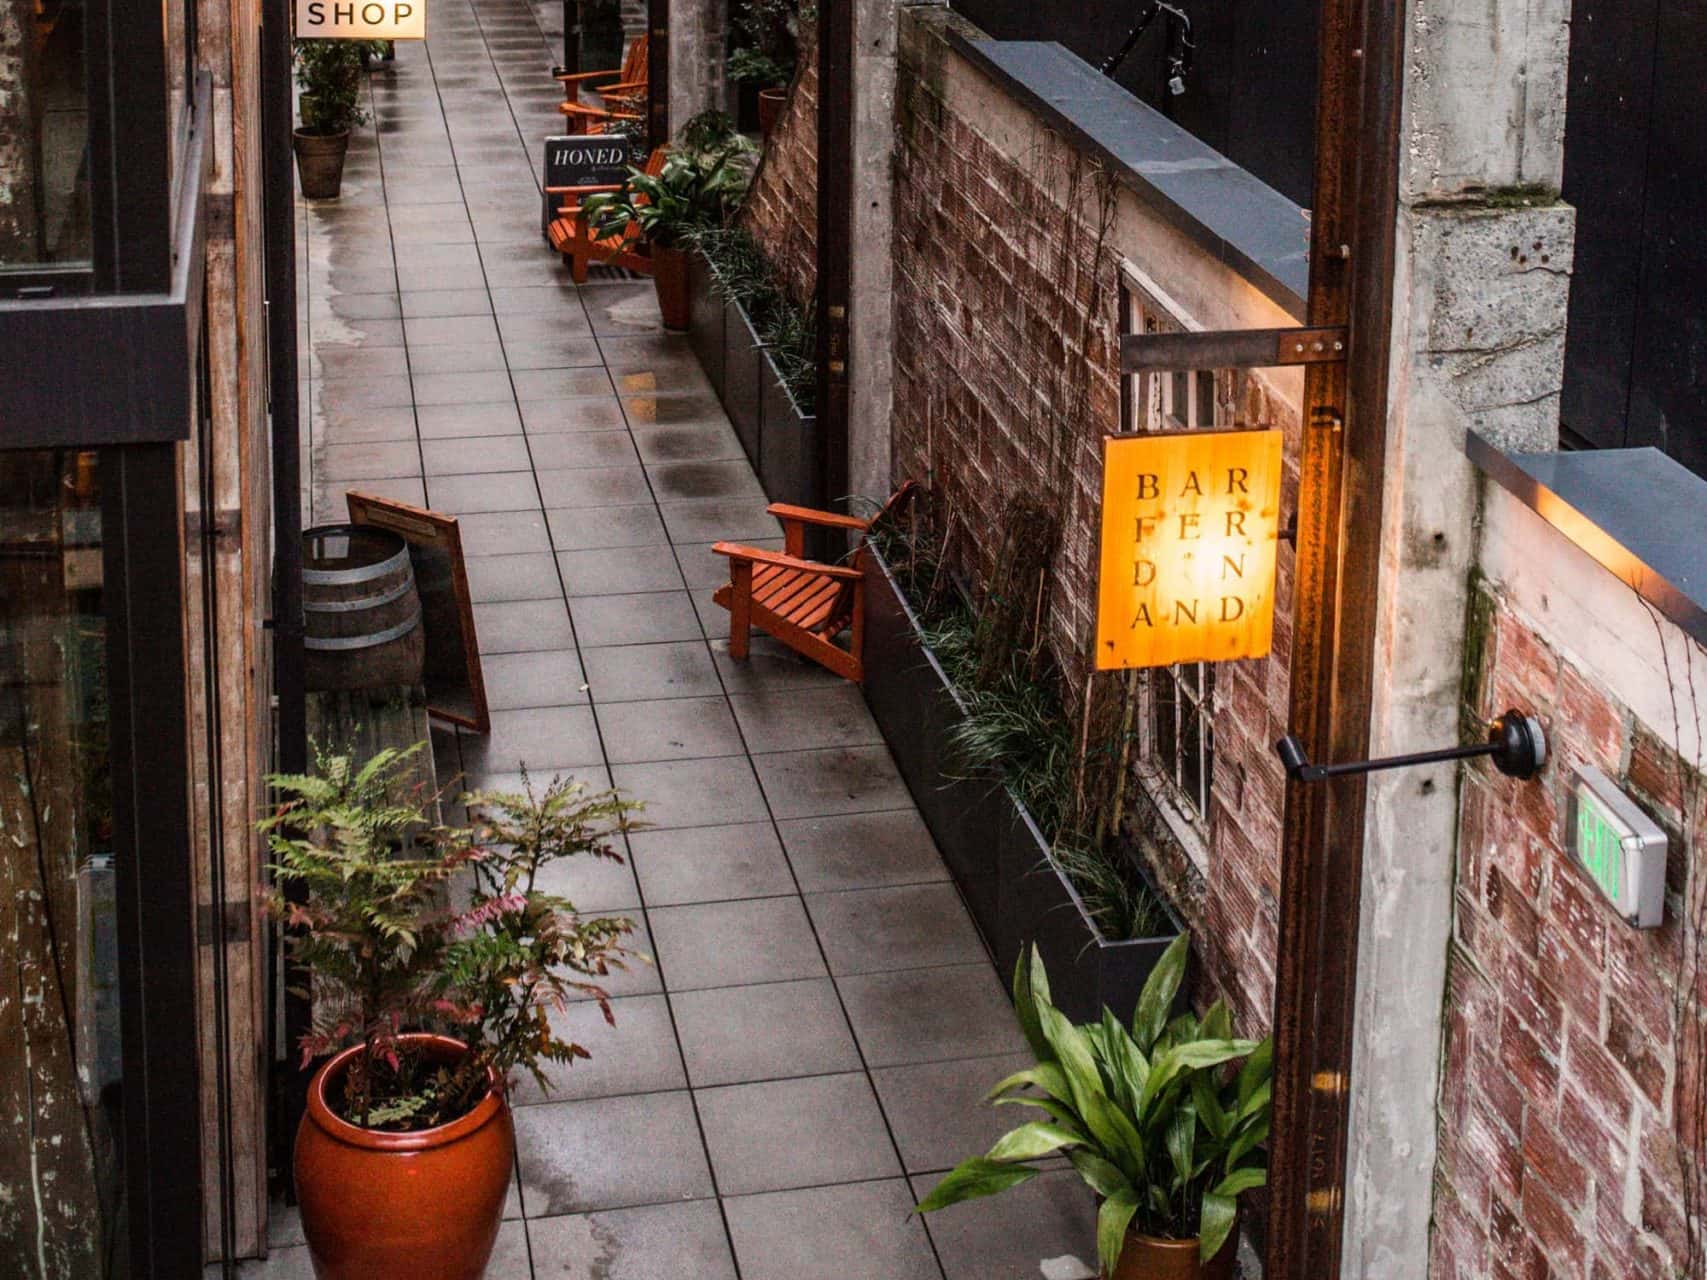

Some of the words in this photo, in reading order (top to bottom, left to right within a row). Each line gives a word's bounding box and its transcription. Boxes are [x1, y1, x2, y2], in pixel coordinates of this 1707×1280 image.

[307, 2, 413, 25] SHOP
[553, 147, 623, 165] HONED
[1136, 467, 1249, 500] BAR
[1134, 510, 1247, 543] FER
[1133, 553, 1245, 587] DN
[1130, 596, 1245, 629] AND
